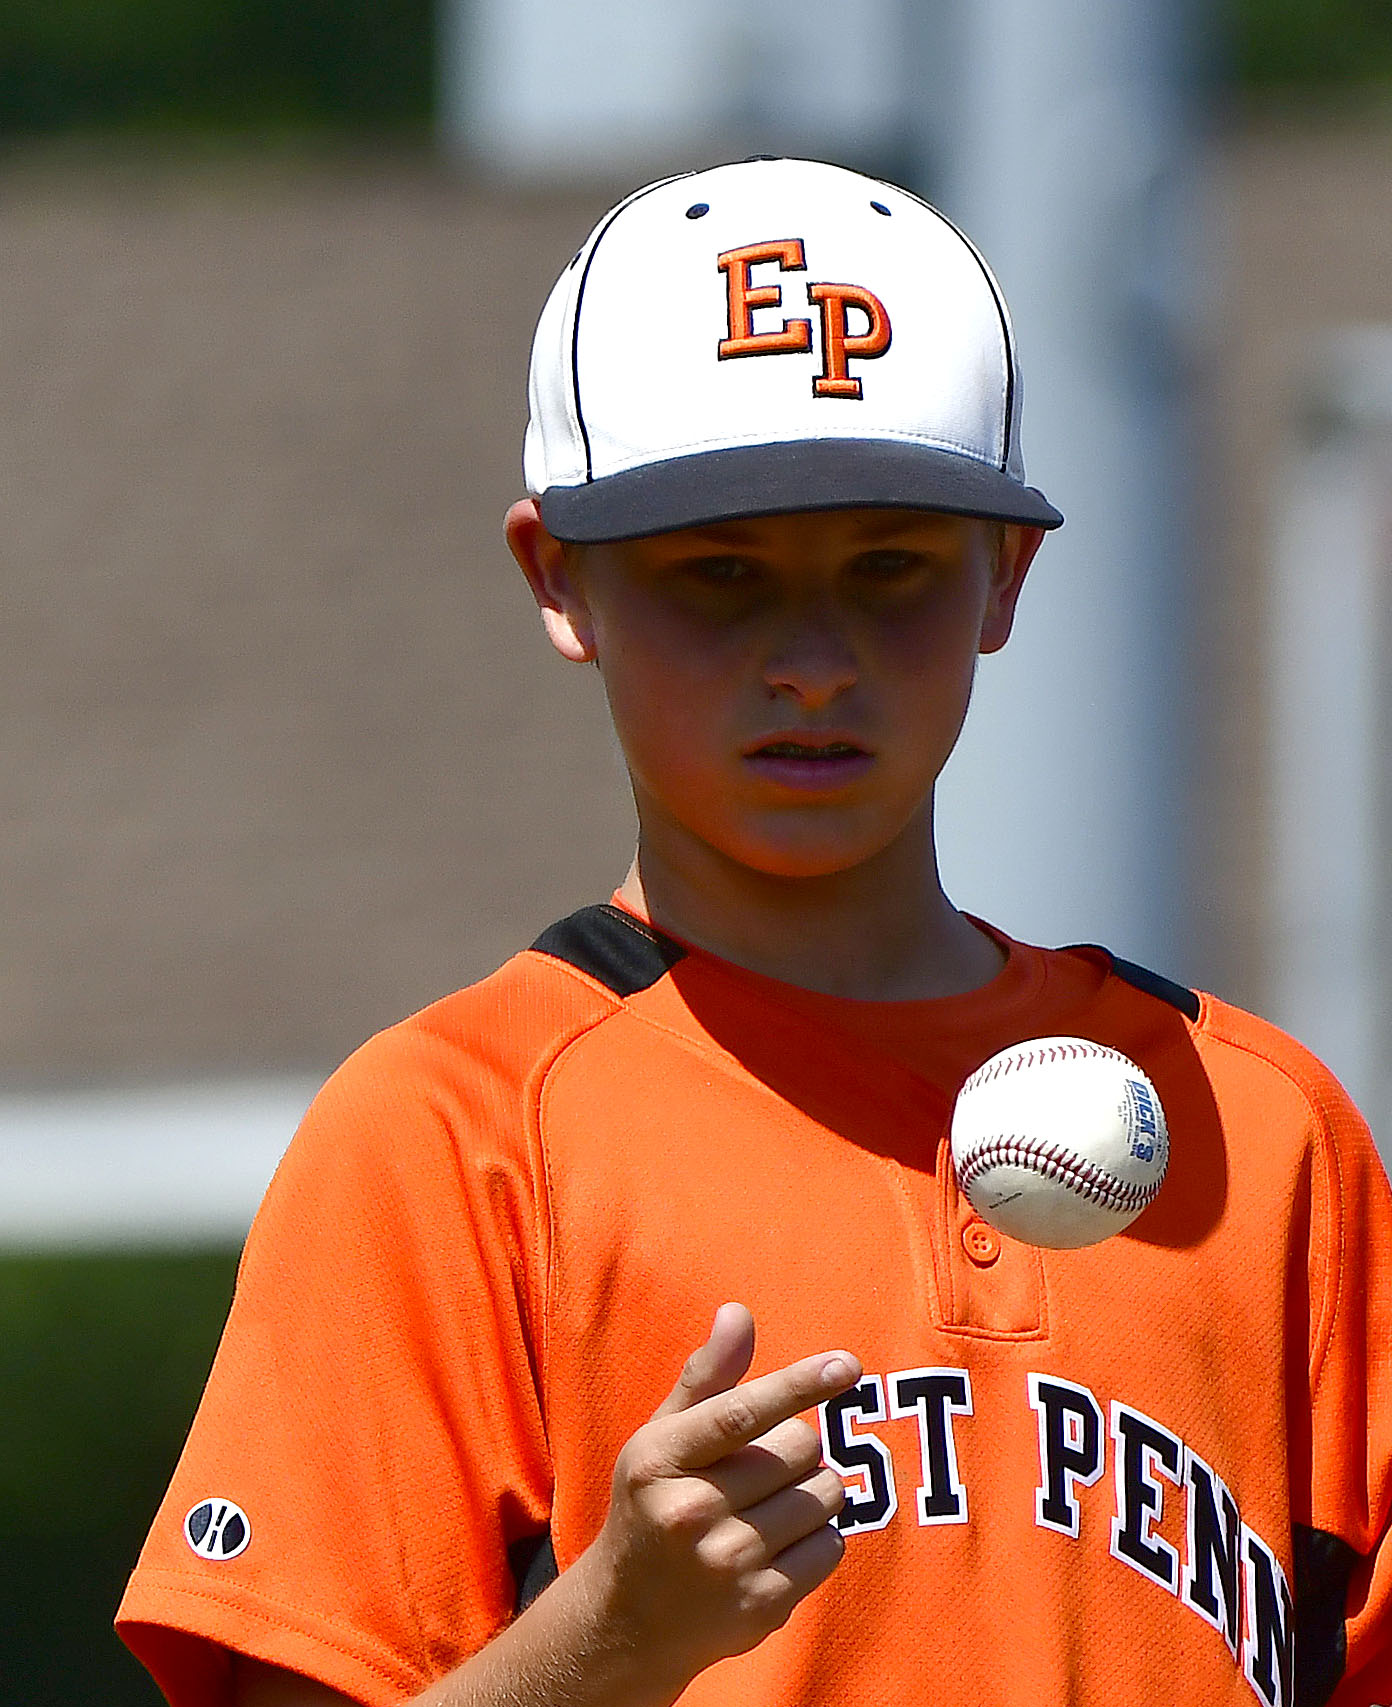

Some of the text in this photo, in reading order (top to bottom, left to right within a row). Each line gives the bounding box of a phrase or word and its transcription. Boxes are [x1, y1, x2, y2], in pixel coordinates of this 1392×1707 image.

[717, 237, 893, 400] EP
[1130, 1080, 1156, 1162] DICK'S
[817, 1366, 975, 1537] ST
